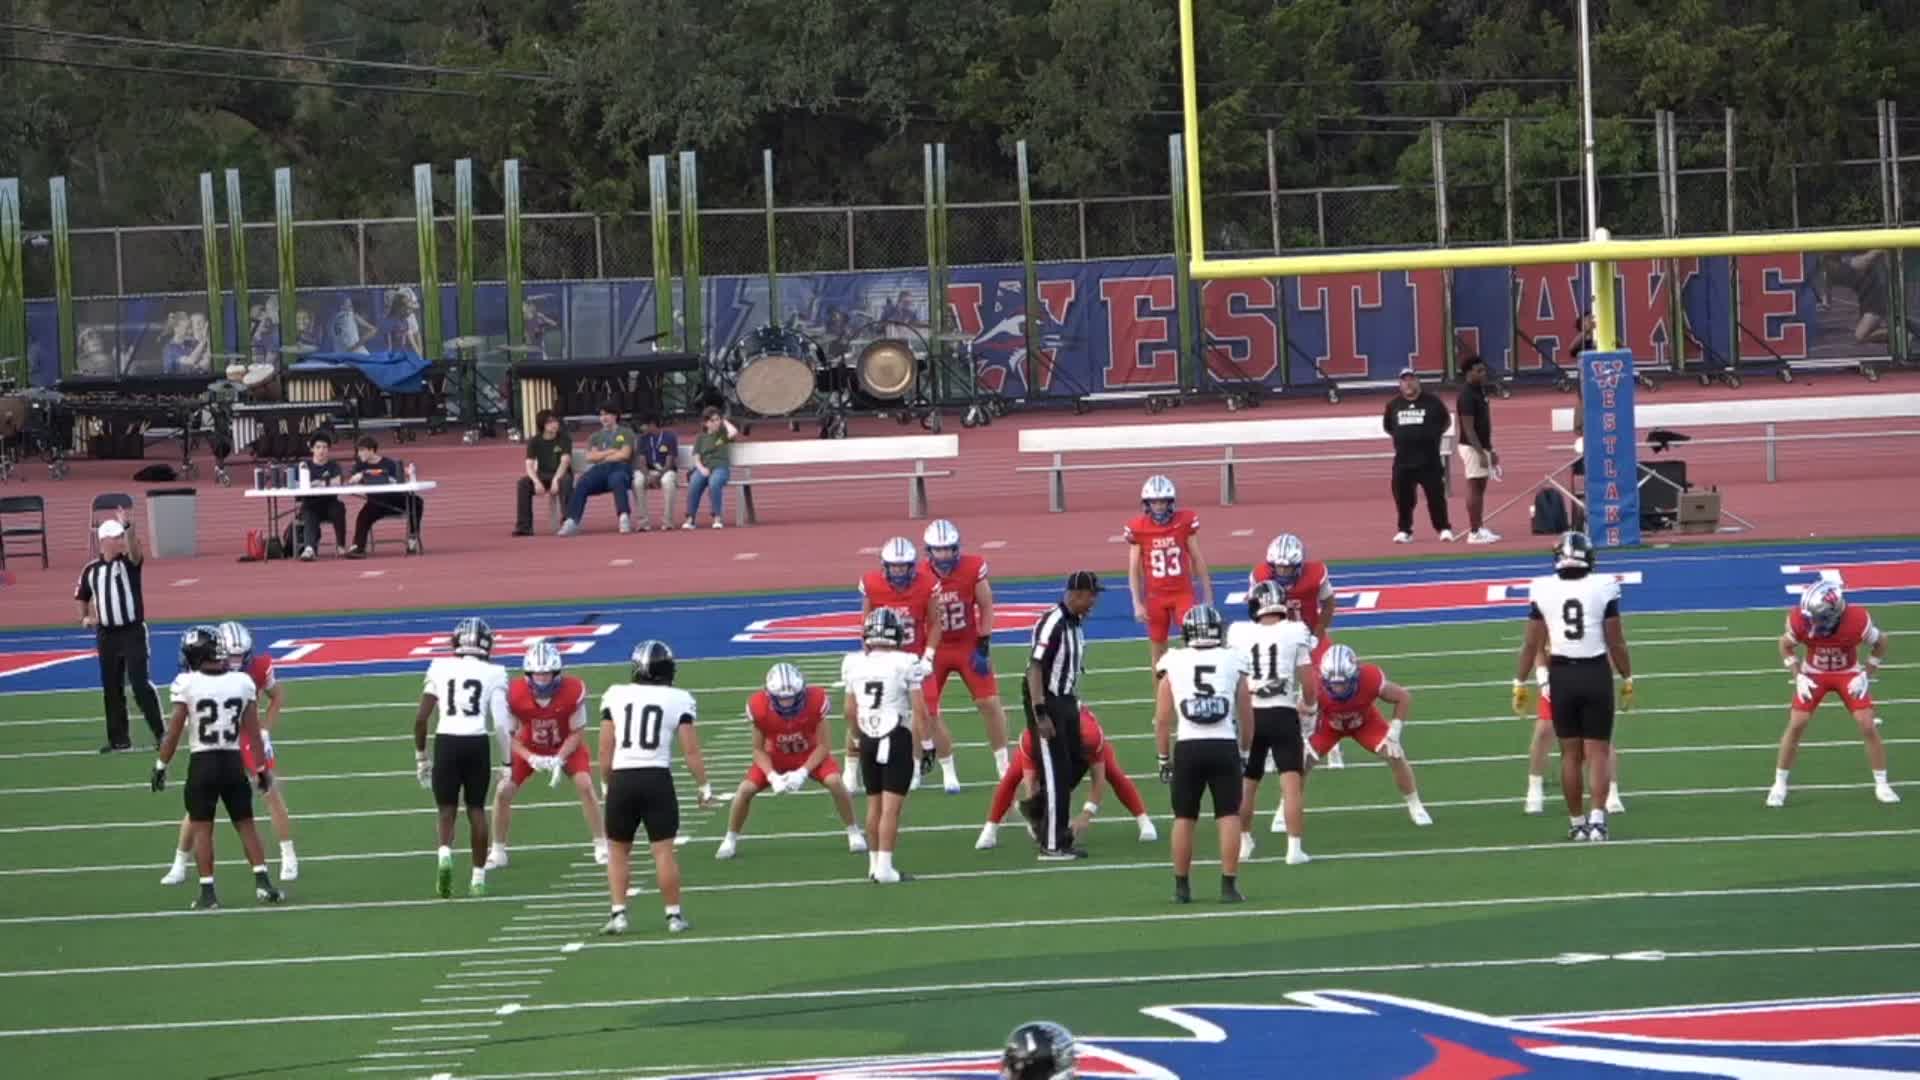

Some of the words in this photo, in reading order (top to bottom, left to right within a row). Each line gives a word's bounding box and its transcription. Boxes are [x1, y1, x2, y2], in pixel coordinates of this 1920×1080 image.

[945, 252, 1809, 392] WESTLAKE
[1591, 360, 1624, 545] WESTLAKE
[1150, 547, 1182, 578] 93
[1562, 599, 1585, 640] 9
[1250, 643, 1279, 680] 11
[447, 679, 482, 717] 13
[864, 681, 884, 710] 7
[1194, 665, 1216, 699] 5
[196, 697, 243, 745] 23
[622, 703, 664, 750] 10
